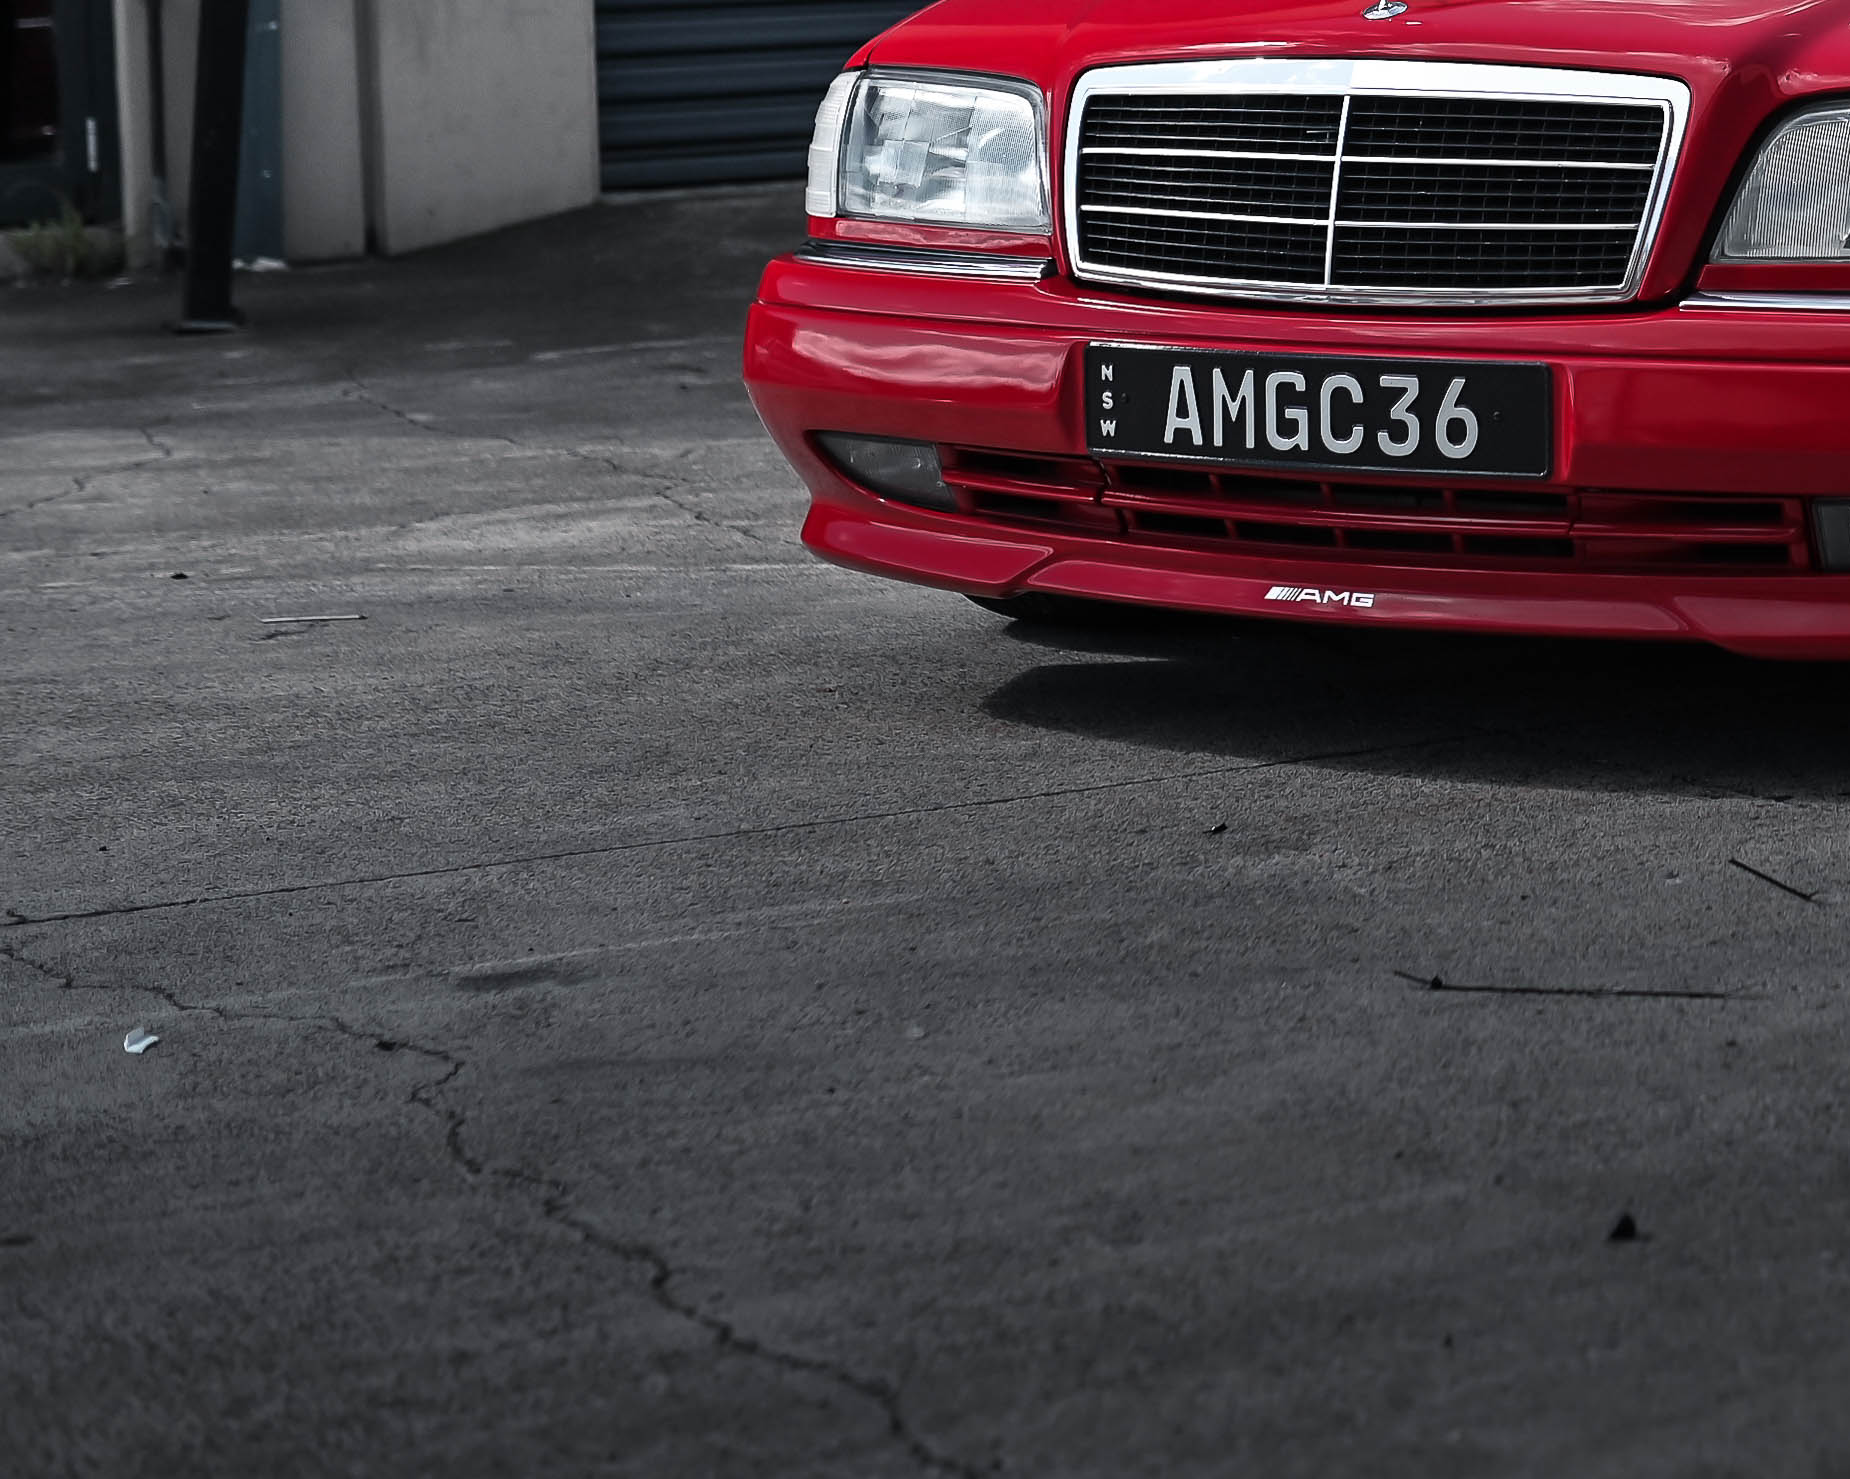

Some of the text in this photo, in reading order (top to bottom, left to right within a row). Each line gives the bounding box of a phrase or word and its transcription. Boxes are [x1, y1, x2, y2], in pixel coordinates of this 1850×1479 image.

[1101, 364, 1116, 438] NSW
[1163, 365, 1480, 459] AMGC36
[1294, 587, 1375, 608] AMG
